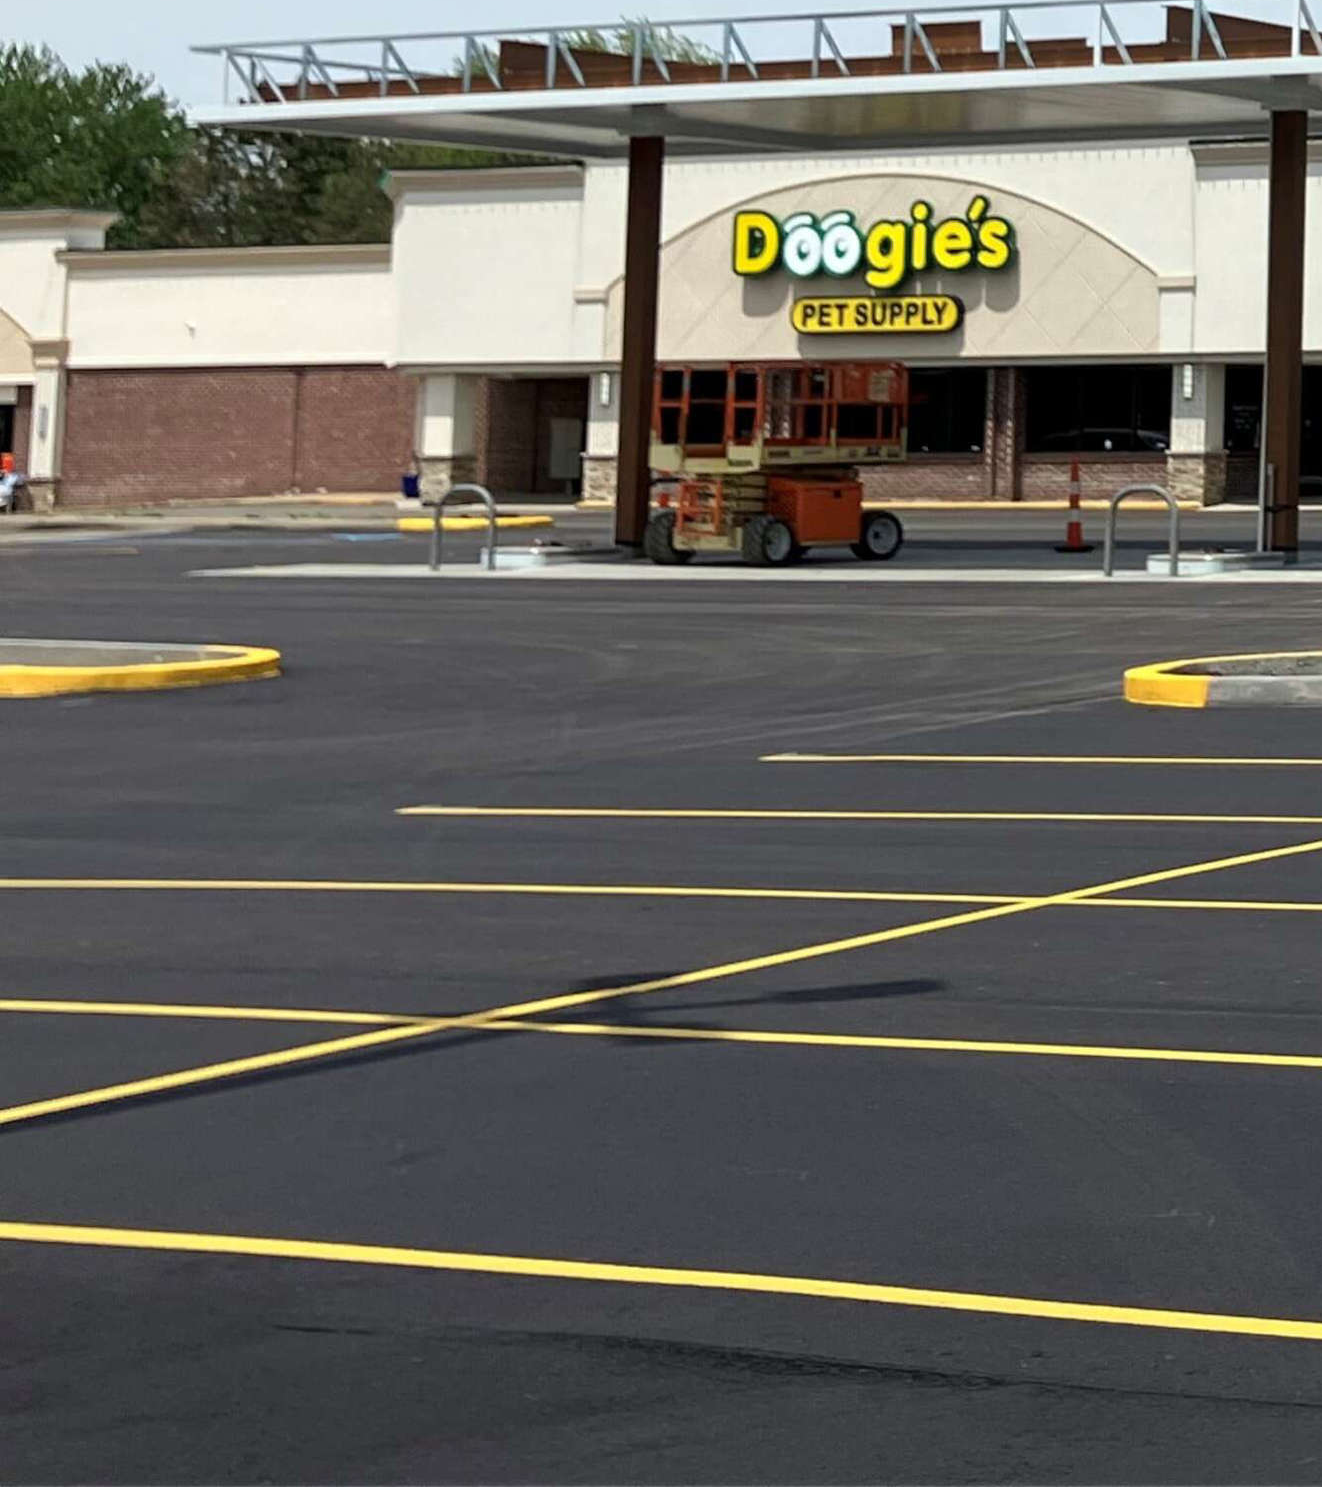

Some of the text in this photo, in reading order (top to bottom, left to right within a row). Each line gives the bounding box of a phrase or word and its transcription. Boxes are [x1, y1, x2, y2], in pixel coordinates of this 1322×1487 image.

[733, 196, 1010, 289] Doogie's
[801, 301, 949, 327] PET SUPPLY
